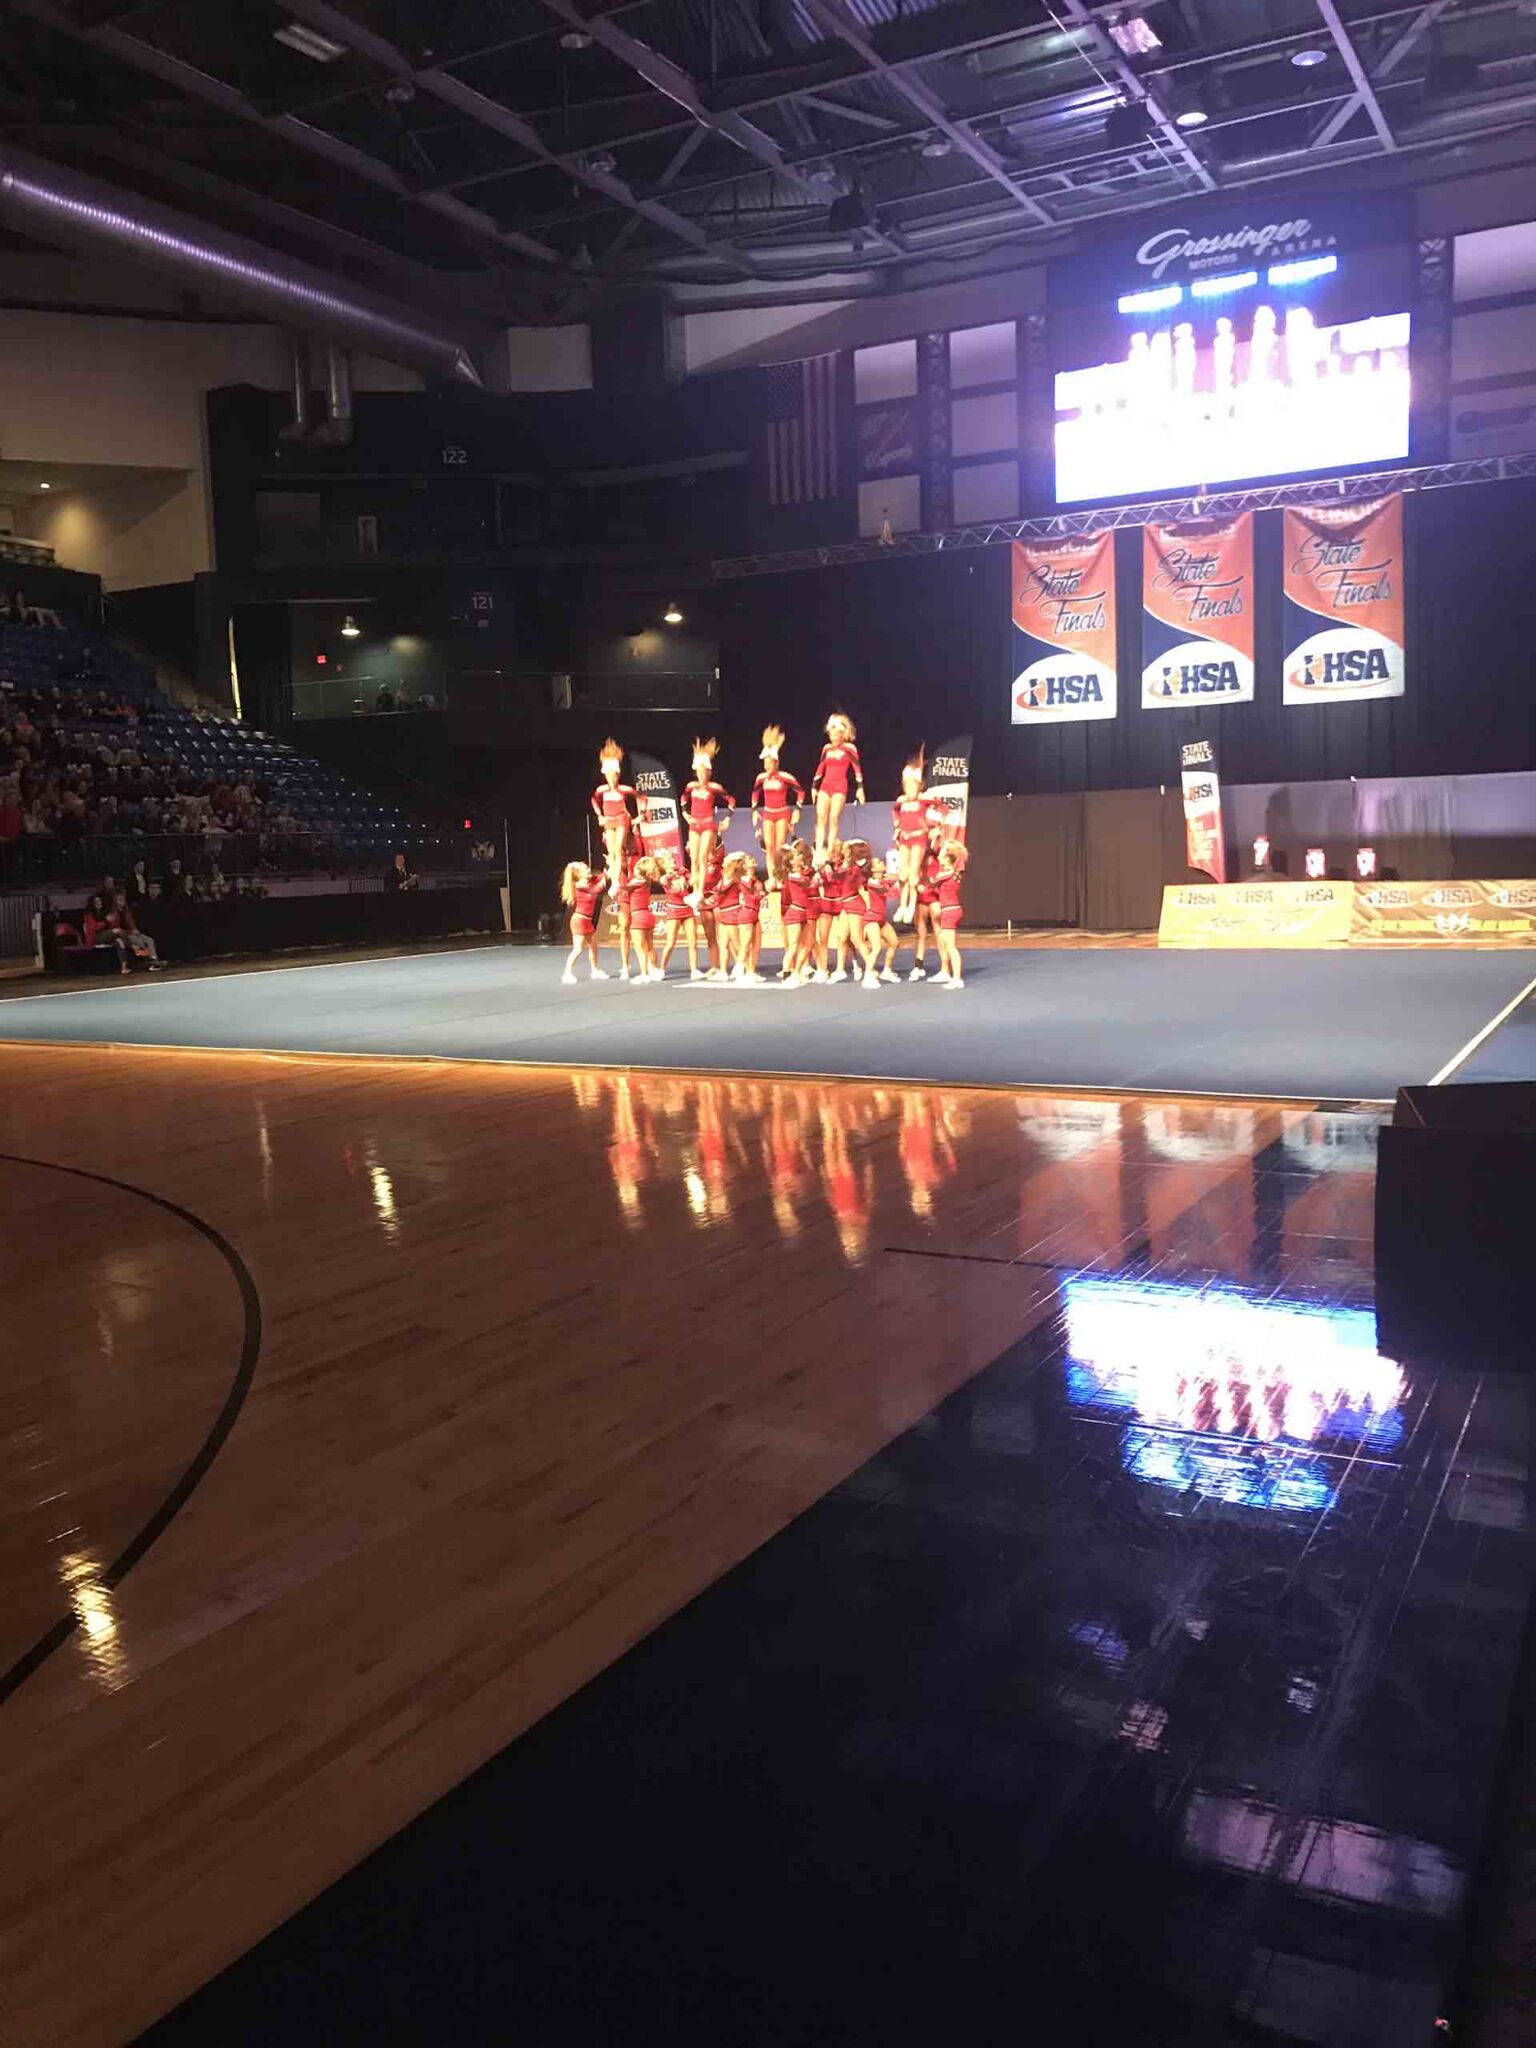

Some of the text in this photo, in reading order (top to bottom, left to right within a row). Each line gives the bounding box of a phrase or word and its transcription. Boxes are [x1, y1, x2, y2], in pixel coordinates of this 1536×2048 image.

[1136, 219, 1311, 279] Grossinger
[1188, 253, 1239, 270] MOTORS
[442, 450, 467, 463] 122
[1292, 534, 1366, 576] State
[1152, 549, 1219, 589] State
[1020, 564, 1084, 604] State
[1315, 558, 1393, 608] Finals
[472, 596, 493, 609] 121
[1173, 575, 1244, 621] Finals
[1040, 591, 1107, 634] Finals
[1182, 741, 1210, 756] STATE
[932, 765, 969, 777] FINALS
[935, 757, 966, 768] STATE
[637, 771, 667, 781] STATE
[636, 779, 671, 792] FINALS
